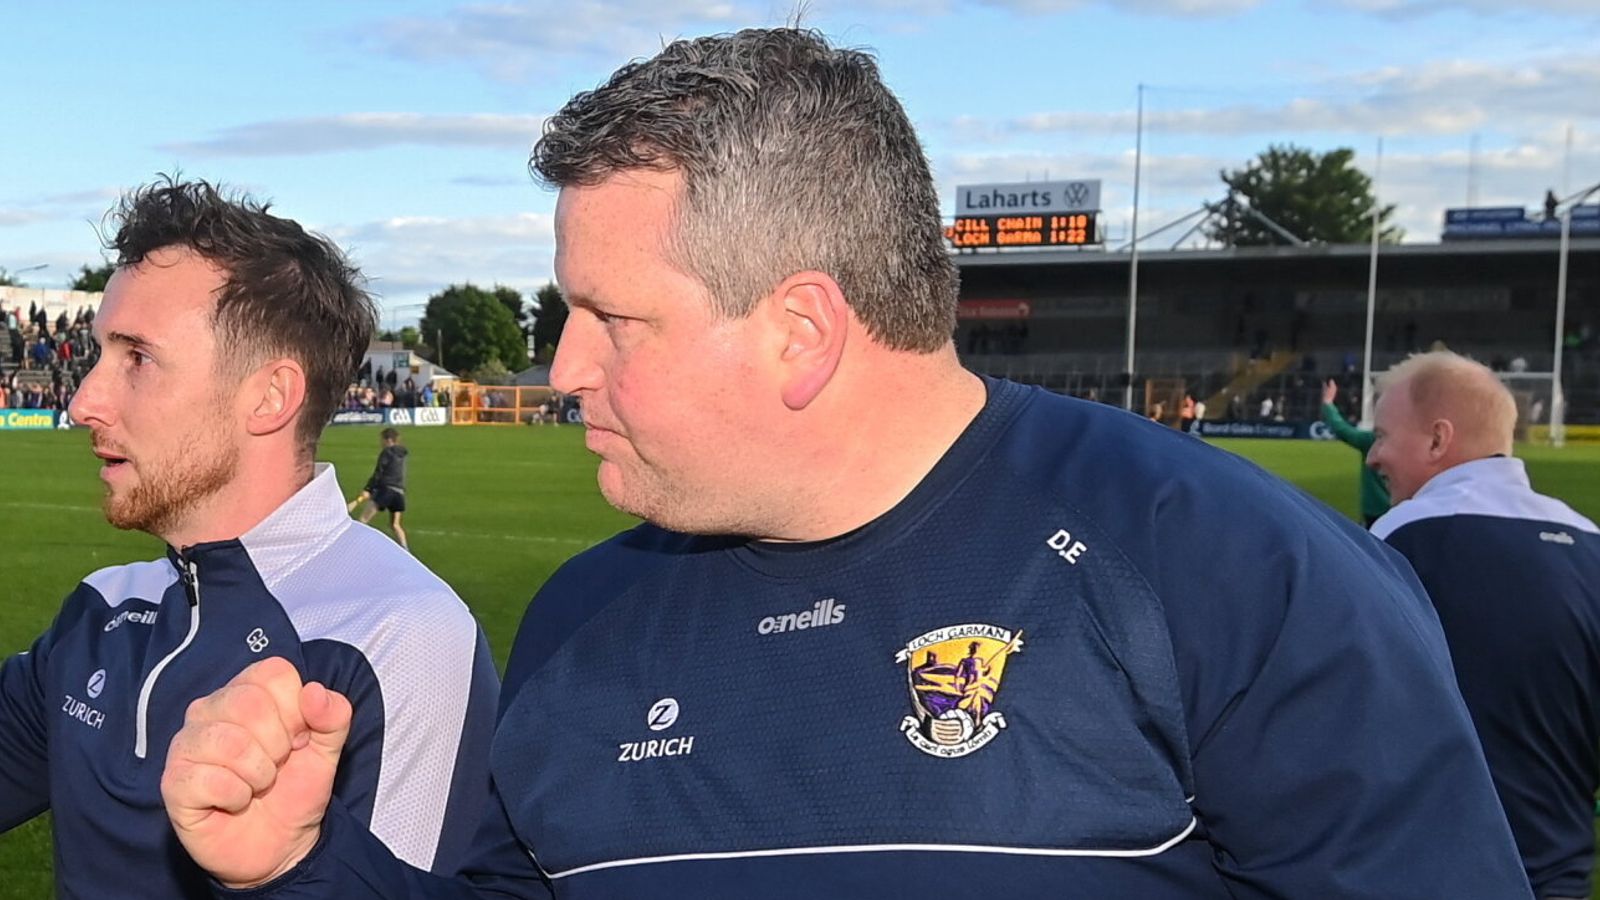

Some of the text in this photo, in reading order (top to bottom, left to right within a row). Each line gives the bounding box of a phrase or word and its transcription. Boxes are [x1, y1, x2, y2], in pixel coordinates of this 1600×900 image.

[966, 189, 1052, 209] Laharts
[955, 218, 990, 231] CILL
[954, 231, 990, 246] LOCH
[8, 411, 52, 427] Centra
[246, 628, 269, 653] GB
[912, 625, 1006, 649] LOCH GARMAN
[62, 695, 106, 729] ZURICH
[618, 736, 694, 762] ZURICH
